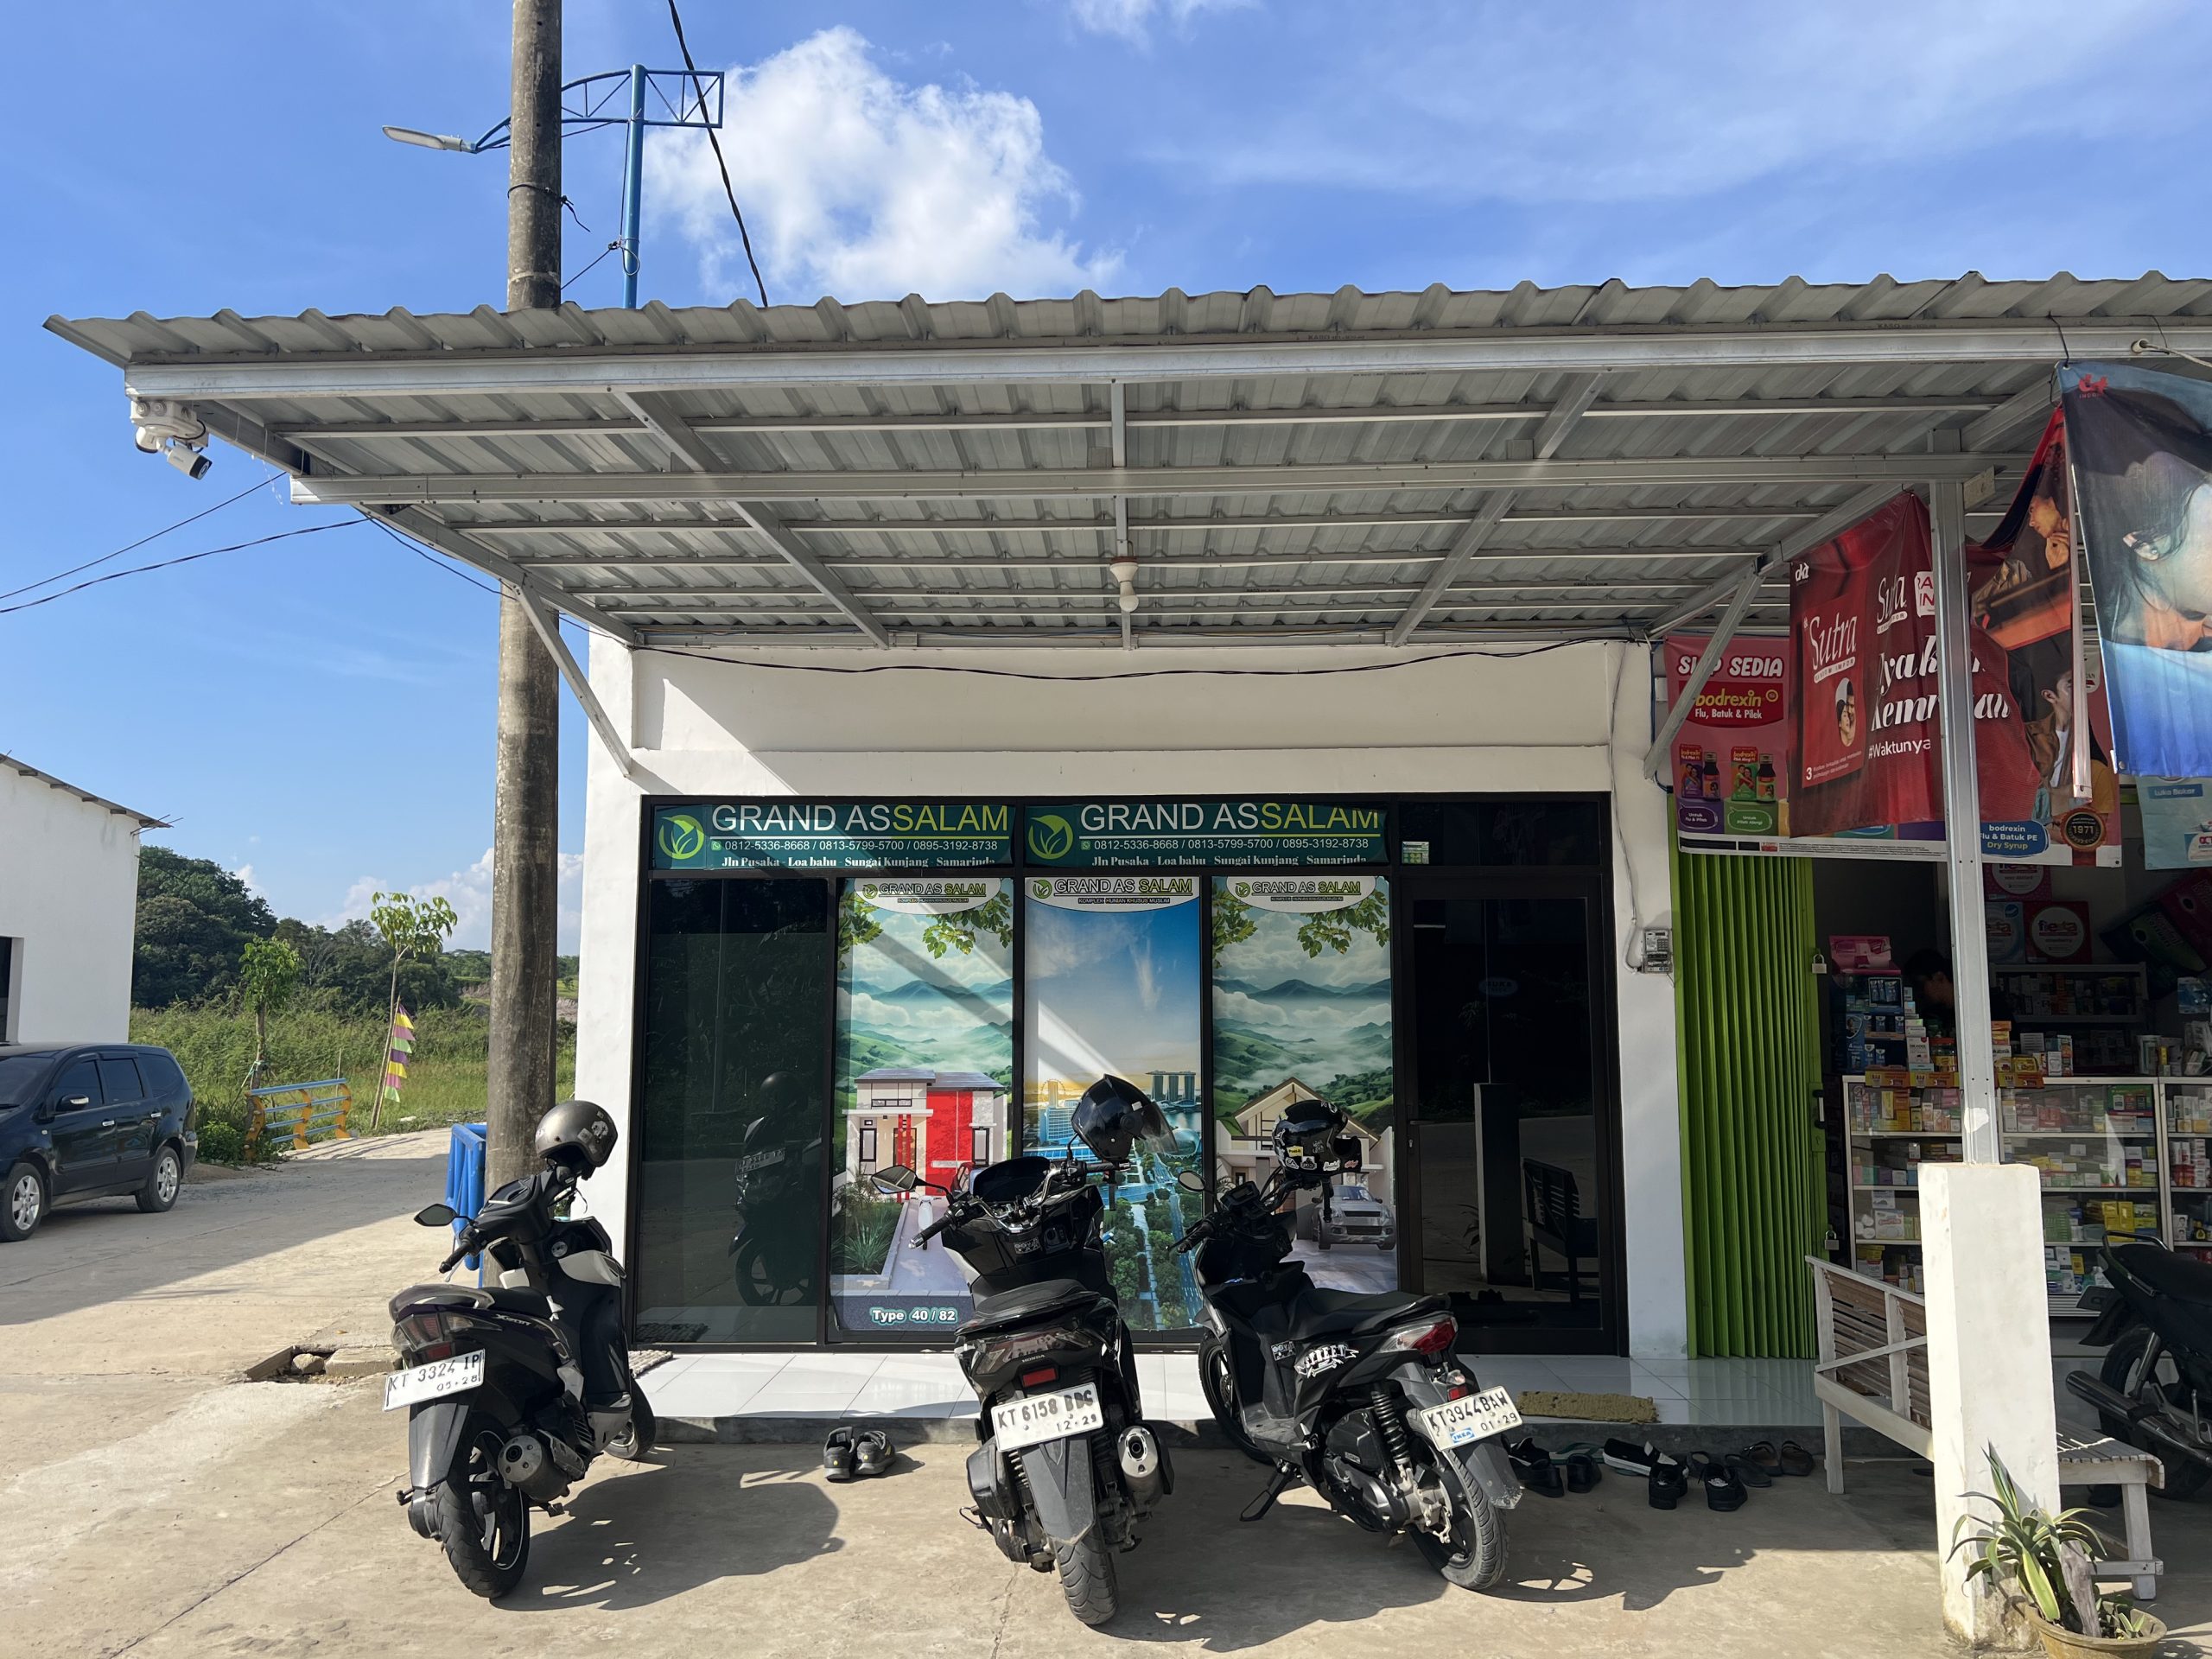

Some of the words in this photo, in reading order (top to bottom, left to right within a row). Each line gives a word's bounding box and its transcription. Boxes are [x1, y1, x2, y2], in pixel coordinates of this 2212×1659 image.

[1809, 612, 1858, 671] Sutra
[1727, 657, 1783, 677] SEDIA
[1694, 709, 1710, 719] Flu,
[1712, 709, 1733, 719] Batuk
[1736, 709, 1742, 719] &
[1744, 709, 1763, 720] Pilek
[1868, 739, 1931, 760] #Waktunya
[1806, 767, 1813, 781] 3
[712, 804, 836, 832] GRAND
[845, 804, 1007, 832] ASSALAM
[1080, 803, 1205, 831] GRAND
[1212, 802, 1380, 830] ASSALAM
[2073, 825, 2094, 835] 1971
[725, 840, 810, 851] 0812-5336-8668
[812, 840, 817, 851] /
[819, 840, 904, 851] 0813-5799-5700
[906, 840, 911, 851] /
[913, 839, 998, 851] 0895-3192-8738
[1094, 839, 1179, 850] 0812-5336-8668
[1181, 839, 1185, 850] /
[1188, 839, 1274, 850] 0813-5799-5700
[1276, 839, 1280, 850] /
[1282, 838, 1369, 850] 0895-3192-8738
[1987, 841, 2002, 849] Dry
[2004, 842, 2029, 850] Syrup
[721, 856, 740, 868] Jln
[741, 856, 780, 868] Pusaka
[787, 856, 809, 868] Loa
[810, 856, 837, 868] bahu
[844, 856, 881, 868] Sungai
[883, 856, 929, 868] Kunjang
[1091, 856, 1109, 866] Jln
[1110, 855, 1150, 866] Pusaka
[1157, 855, 1178, 866] Loa
[1179, 855, 1206, 866] bahu
[1214, 855, 1252, 867] Sungai
[1253, 855, 1300, 867] Kunjang
[879, 883, 925, 895] GRAND
[925, 883, 942, 895] AS
[944, 883, 987, 895] SALAM
[1054, 878, 1111, 893] GRAND
[1113, 878, 1135, 893] AS
[1139, 878, 1193, 893] SALAM
[1252, 880, 1297, 893] GRAND
[1297, 880, 1316, 893] AS
[1318, 880, 1361, 893] SALAM
[872, 1310, 905, 1323] Type
[912, 1310, 928, 1320] 40
[931, 1310, 935, 1321] /
[938, 1310, 956, 1320] 82
[1021, 1354, 1046, 1363] HONDA
[1305, 1344, 1345, 1370] STREET
[389, 1373, 410, 1392] KT
[417, 1361, 455, 1382] 3324
[464, 1353, 480, 1370] IP
[997, 1408, 1015, 1429] KT
[1021, 1398, 1058, 1421] 6158
